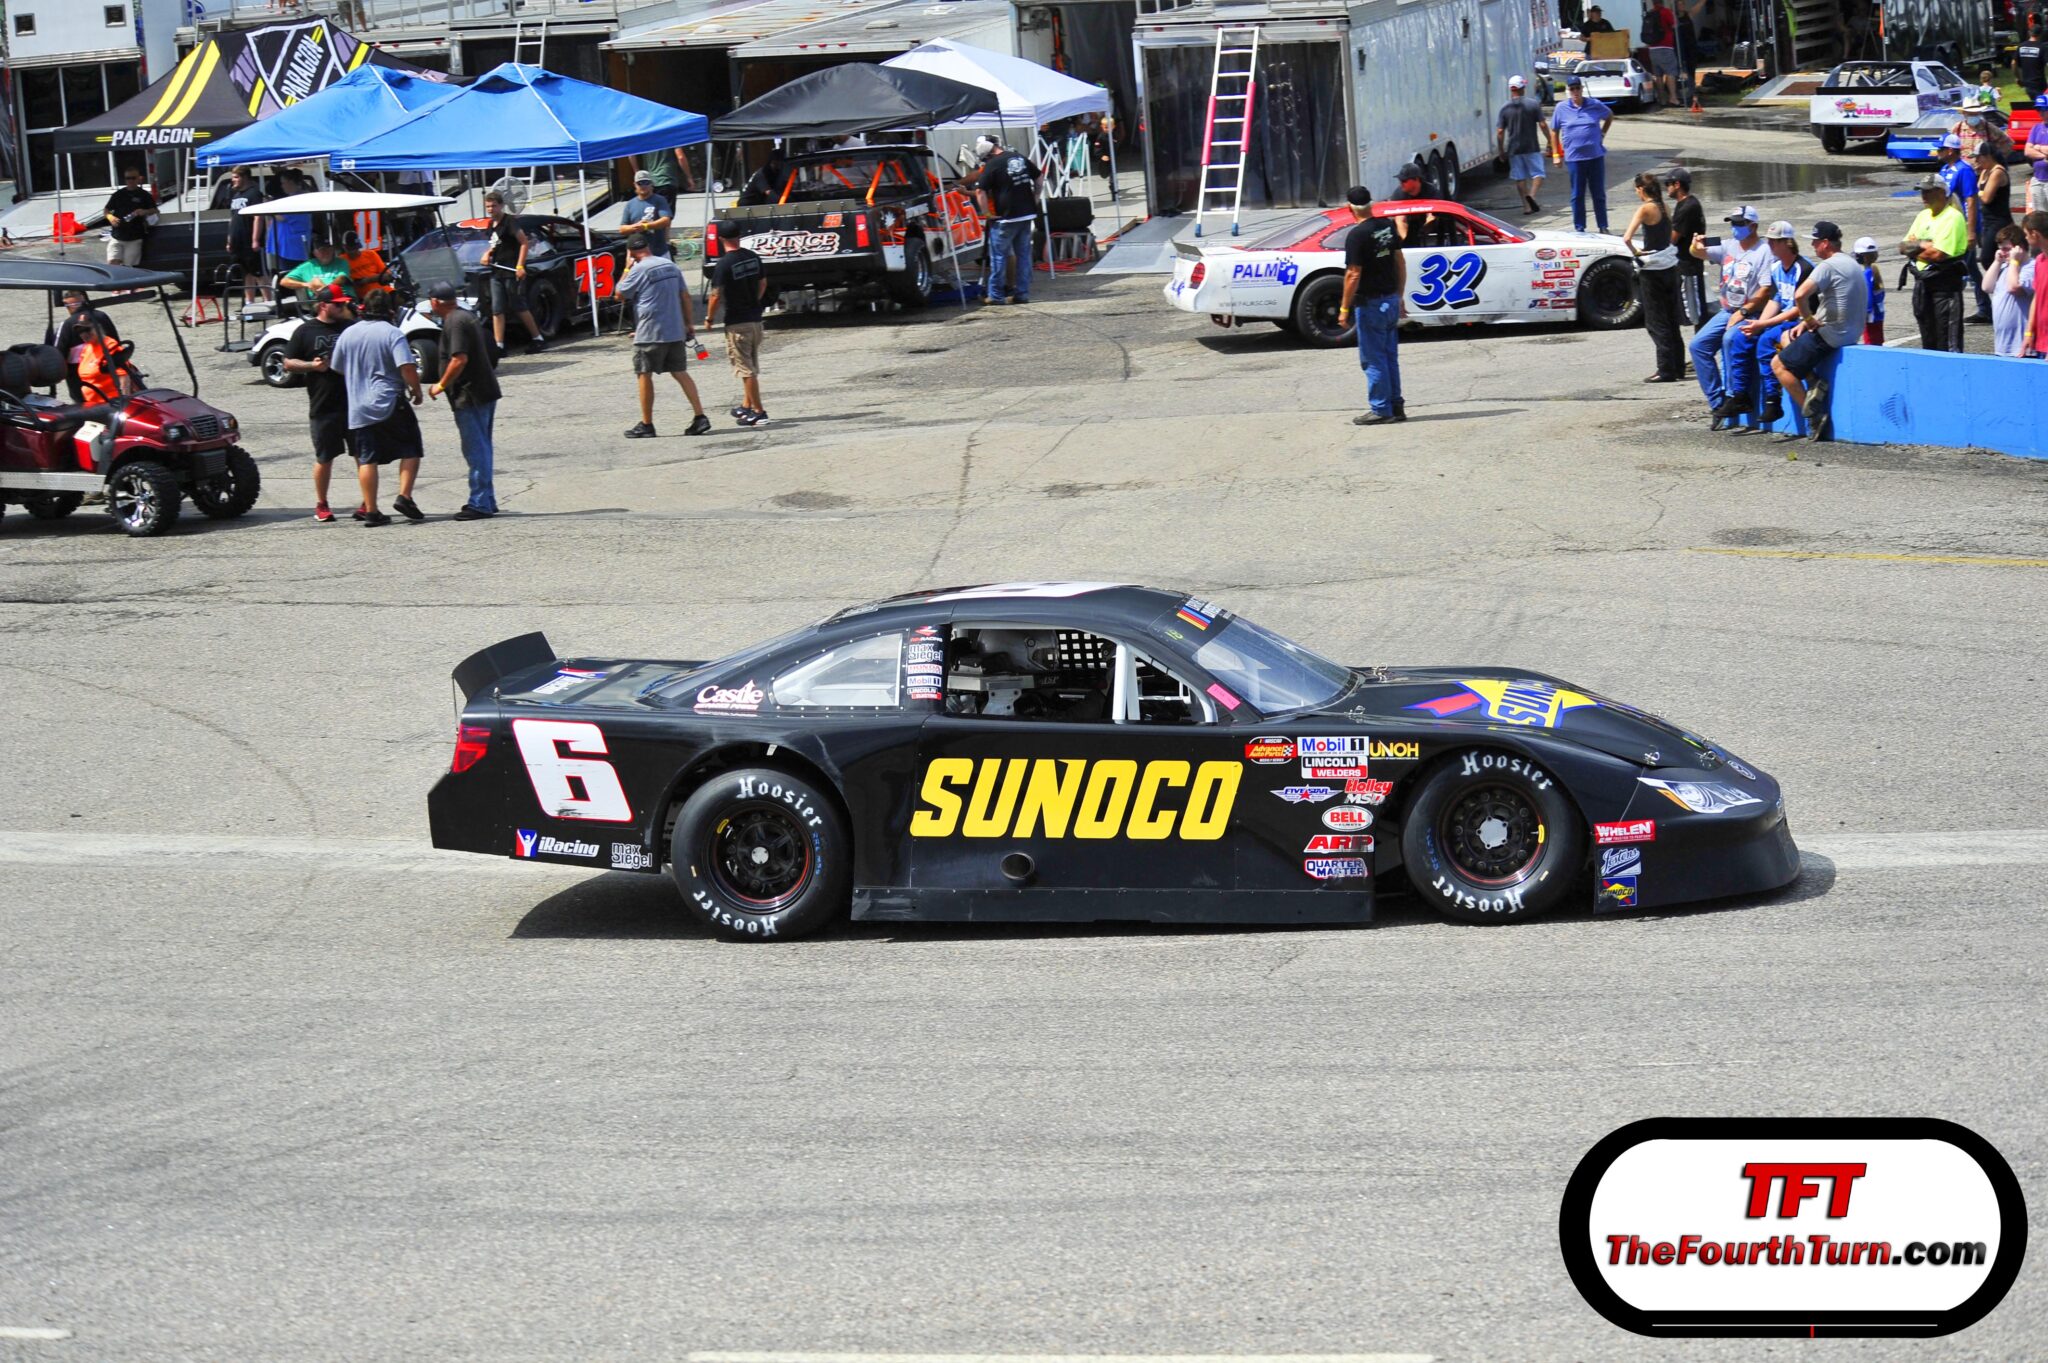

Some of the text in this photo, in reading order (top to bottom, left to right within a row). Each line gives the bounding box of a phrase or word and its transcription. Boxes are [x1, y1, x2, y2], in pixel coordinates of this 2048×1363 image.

[111, 128, 195, 146] PARAGON
[752, 233, 837, 250] PRINCE
[1411, 252, 1487, 311] 32
[909, 643, 934, 652] max
[909, 677, 932, 685] Mobil
[697, 679, 763, 704] Castle
[1302, 738, 1345, 751] Mobil
[1369, 741, 1419, 758] UNOH
[512, 718, 633, 822] 6
[1305, 758, 1356, 767] LINCOLN
[1460, 751, 1553, 790] Hoosier
[1316, 769, 1361, 777] WELDERS
[1345, 779, 1393, 795] Holley
[736, 776, 823, 827] Hoosier
[909, 757, 1244, 840] SUNOCO
[1344, 793, 1386, 805] MSD
[1330, 812, 1365, 823] BELL
[1596, 821, 1651, 837] WHELEN
[538, 837, 600, 857] iRacing
[612, 843, 642, 855] max
[1306, 836, 1373, 850] ARP
[611, 853, 653, 869] Siegel
[1306, 860, 1362, 871] QUARTER
[1316, 867, 1364, 877] MASTER
[1433, 875, 1525, 913] Hoosier
[693, 889, 778, 936] Hoosier
